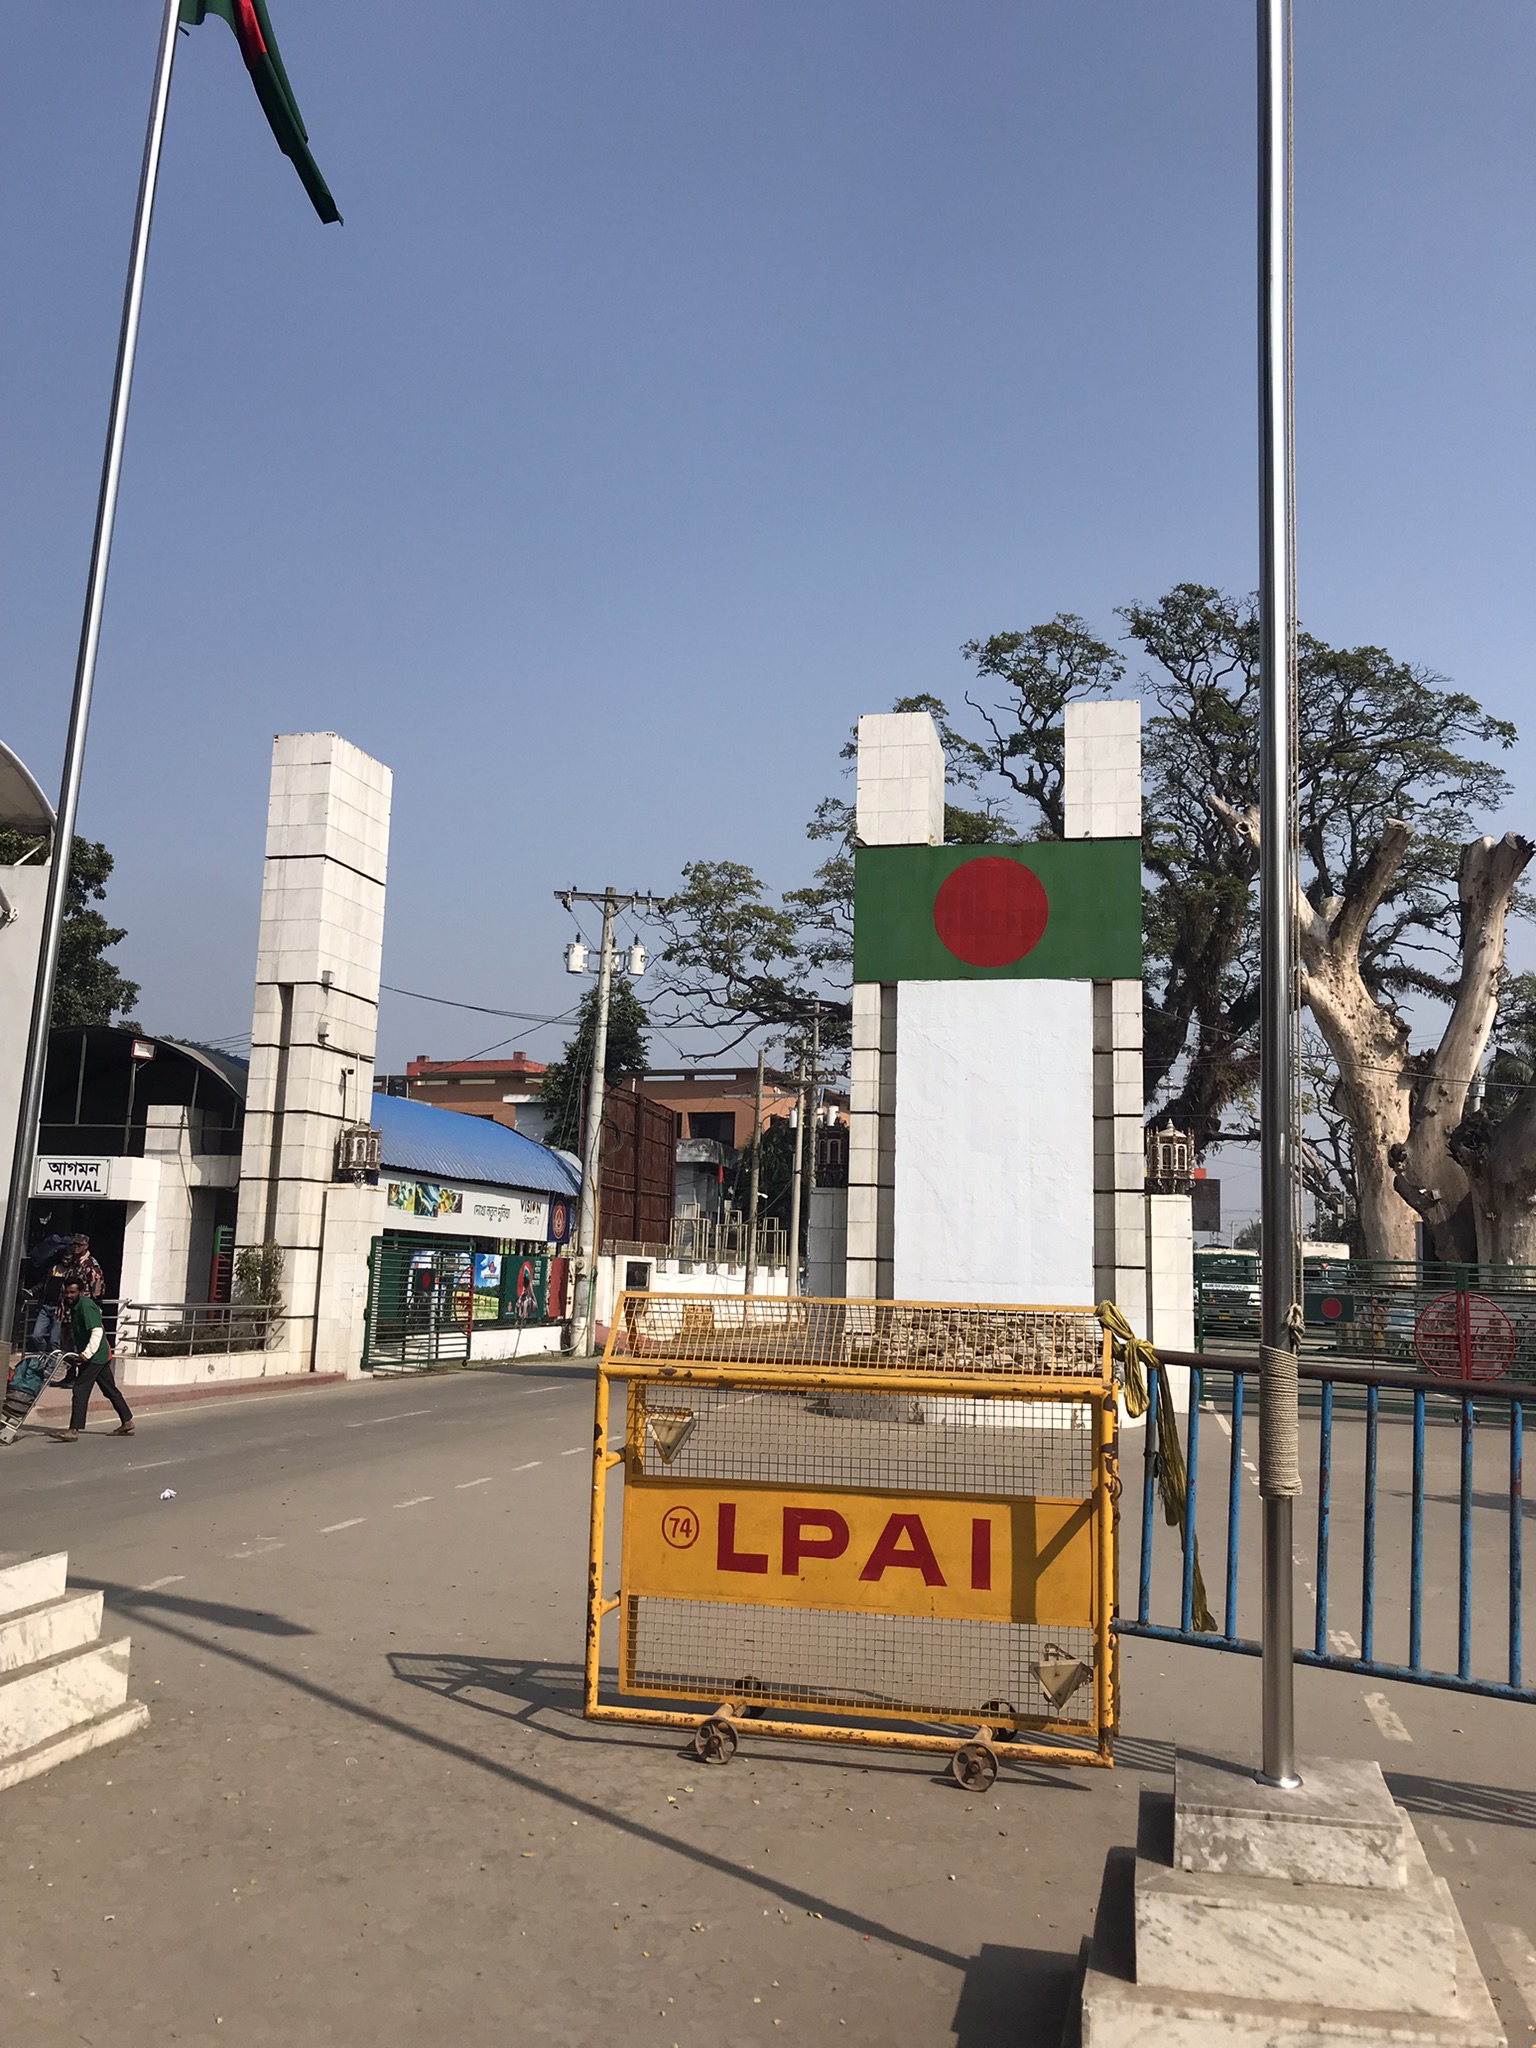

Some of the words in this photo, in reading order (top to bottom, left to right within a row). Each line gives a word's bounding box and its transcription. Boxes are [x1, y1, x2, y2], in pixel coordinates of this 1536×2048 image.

[47, 1161, 101, 1176] আগমন
[43, 1179, 101, 1192] ARRIVAL
[669, 1517, 692, 1538] 74
[717, 1502, 991, 1590] LPAI
